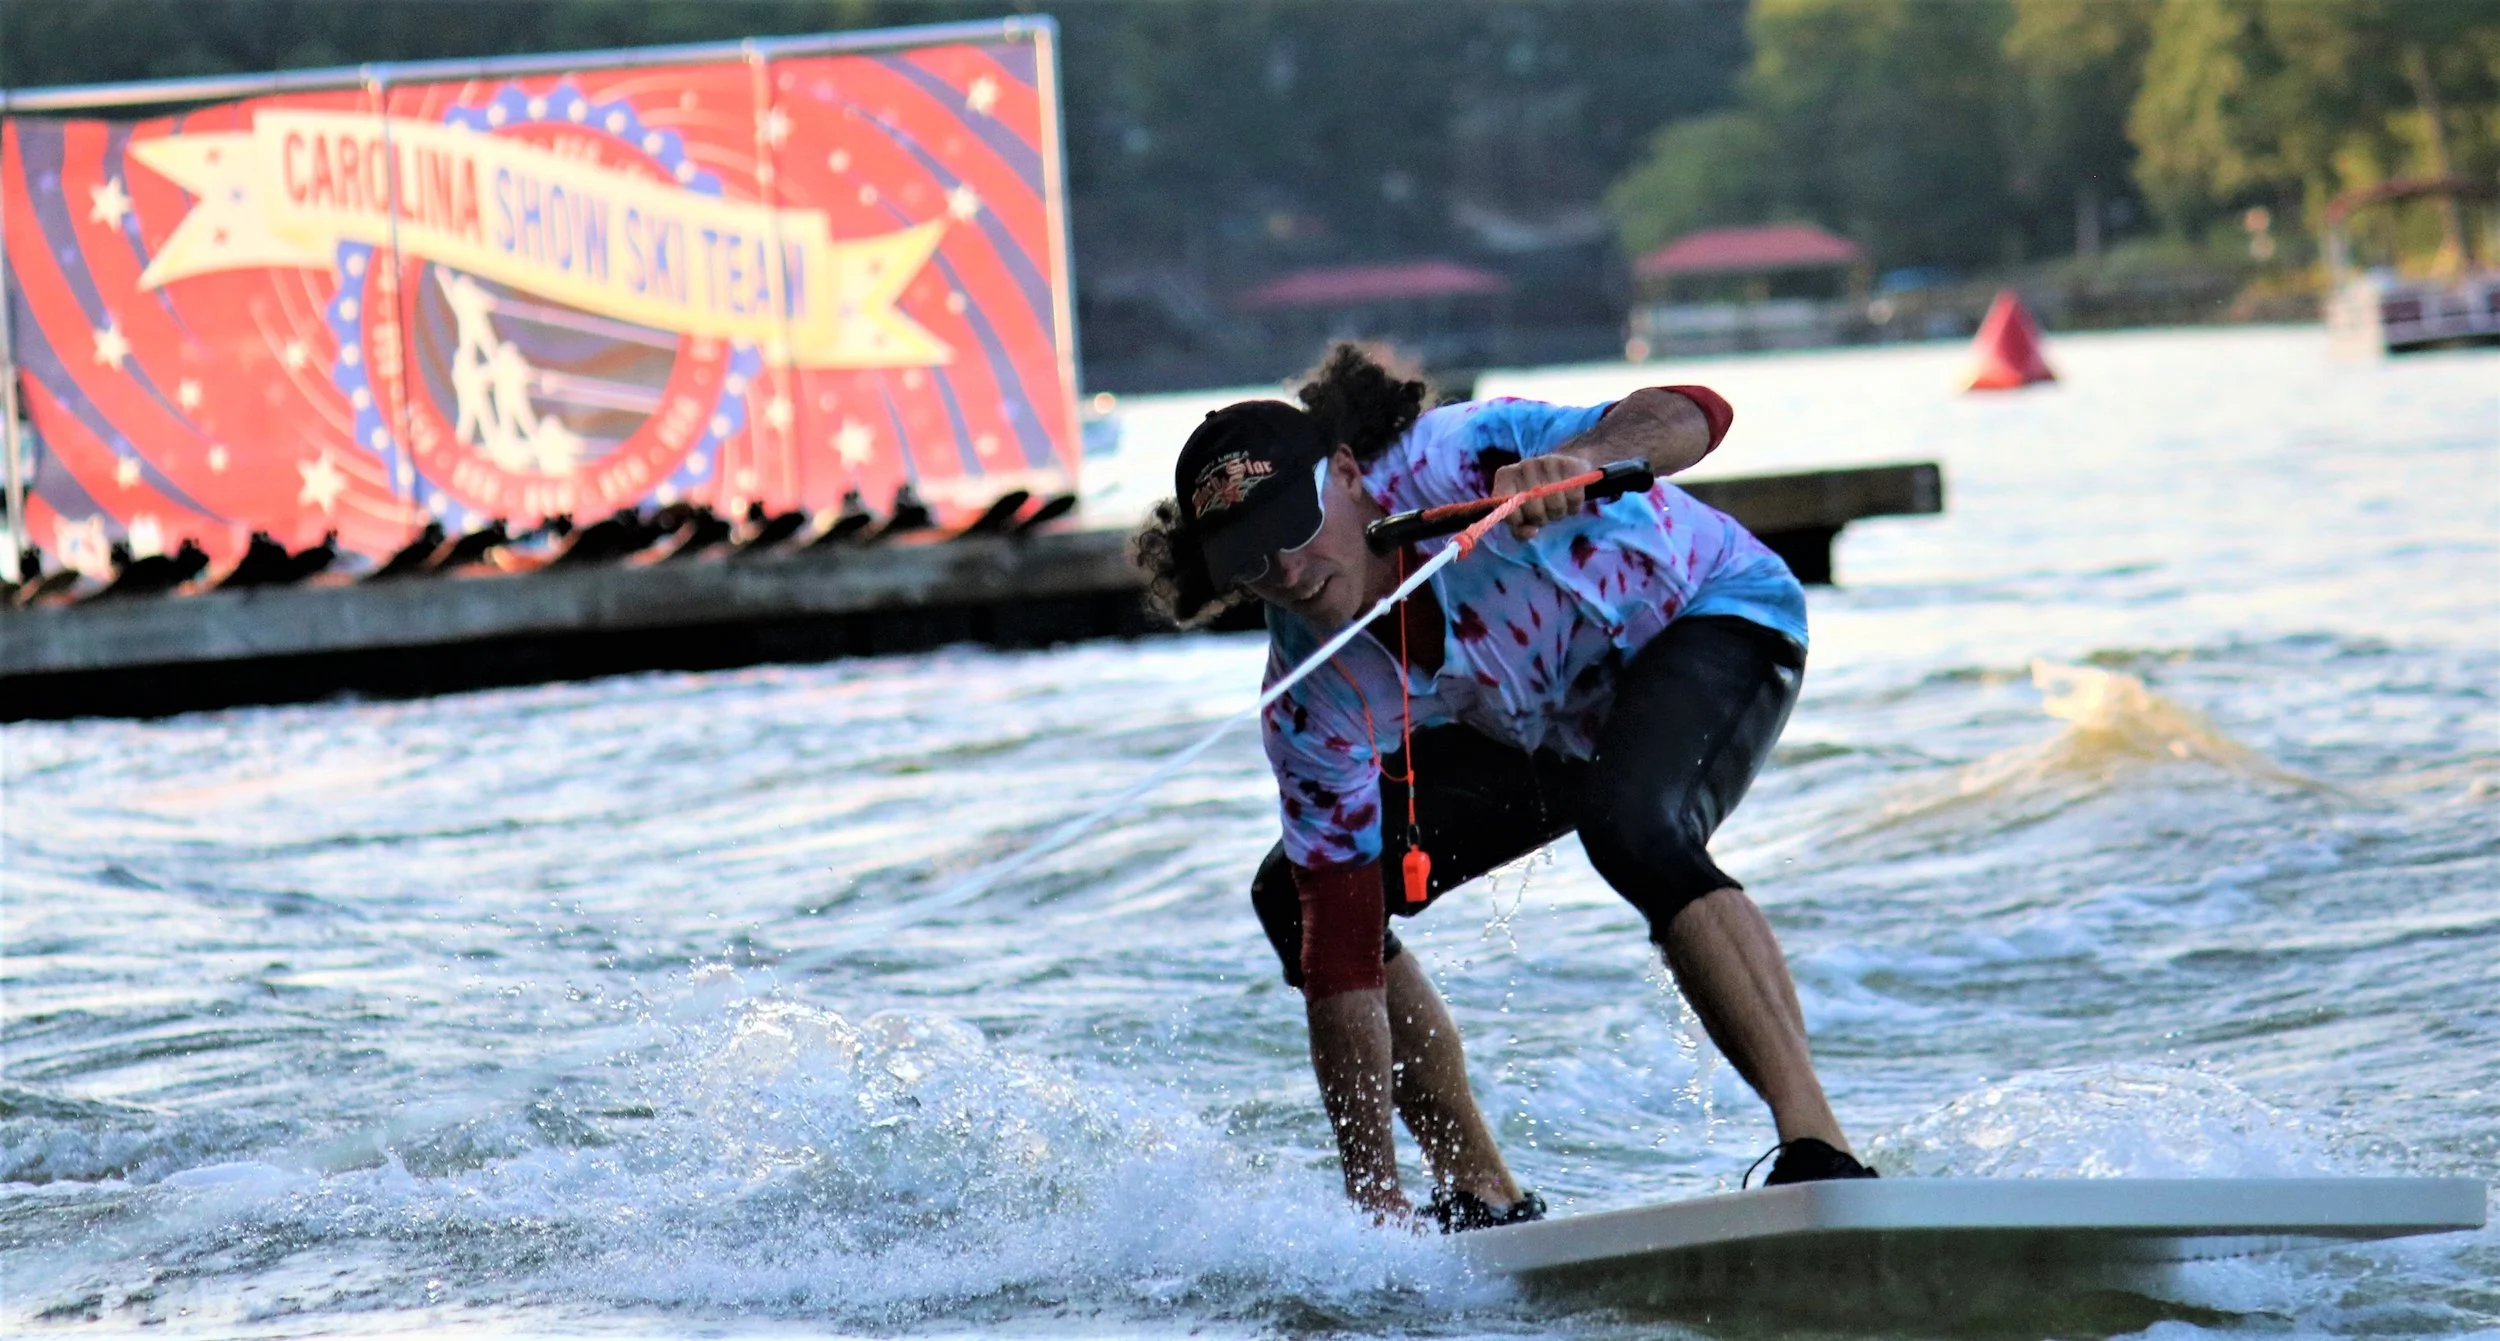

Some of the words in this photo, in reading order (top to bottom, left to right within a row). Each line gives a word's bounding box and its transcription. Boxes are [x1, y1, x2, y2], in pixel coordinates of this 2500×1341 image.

[281, 129, 485, 248] CAROLINA
[496, 165, 609, 282] SHOW
[625, 207, 688, 306] SKI
